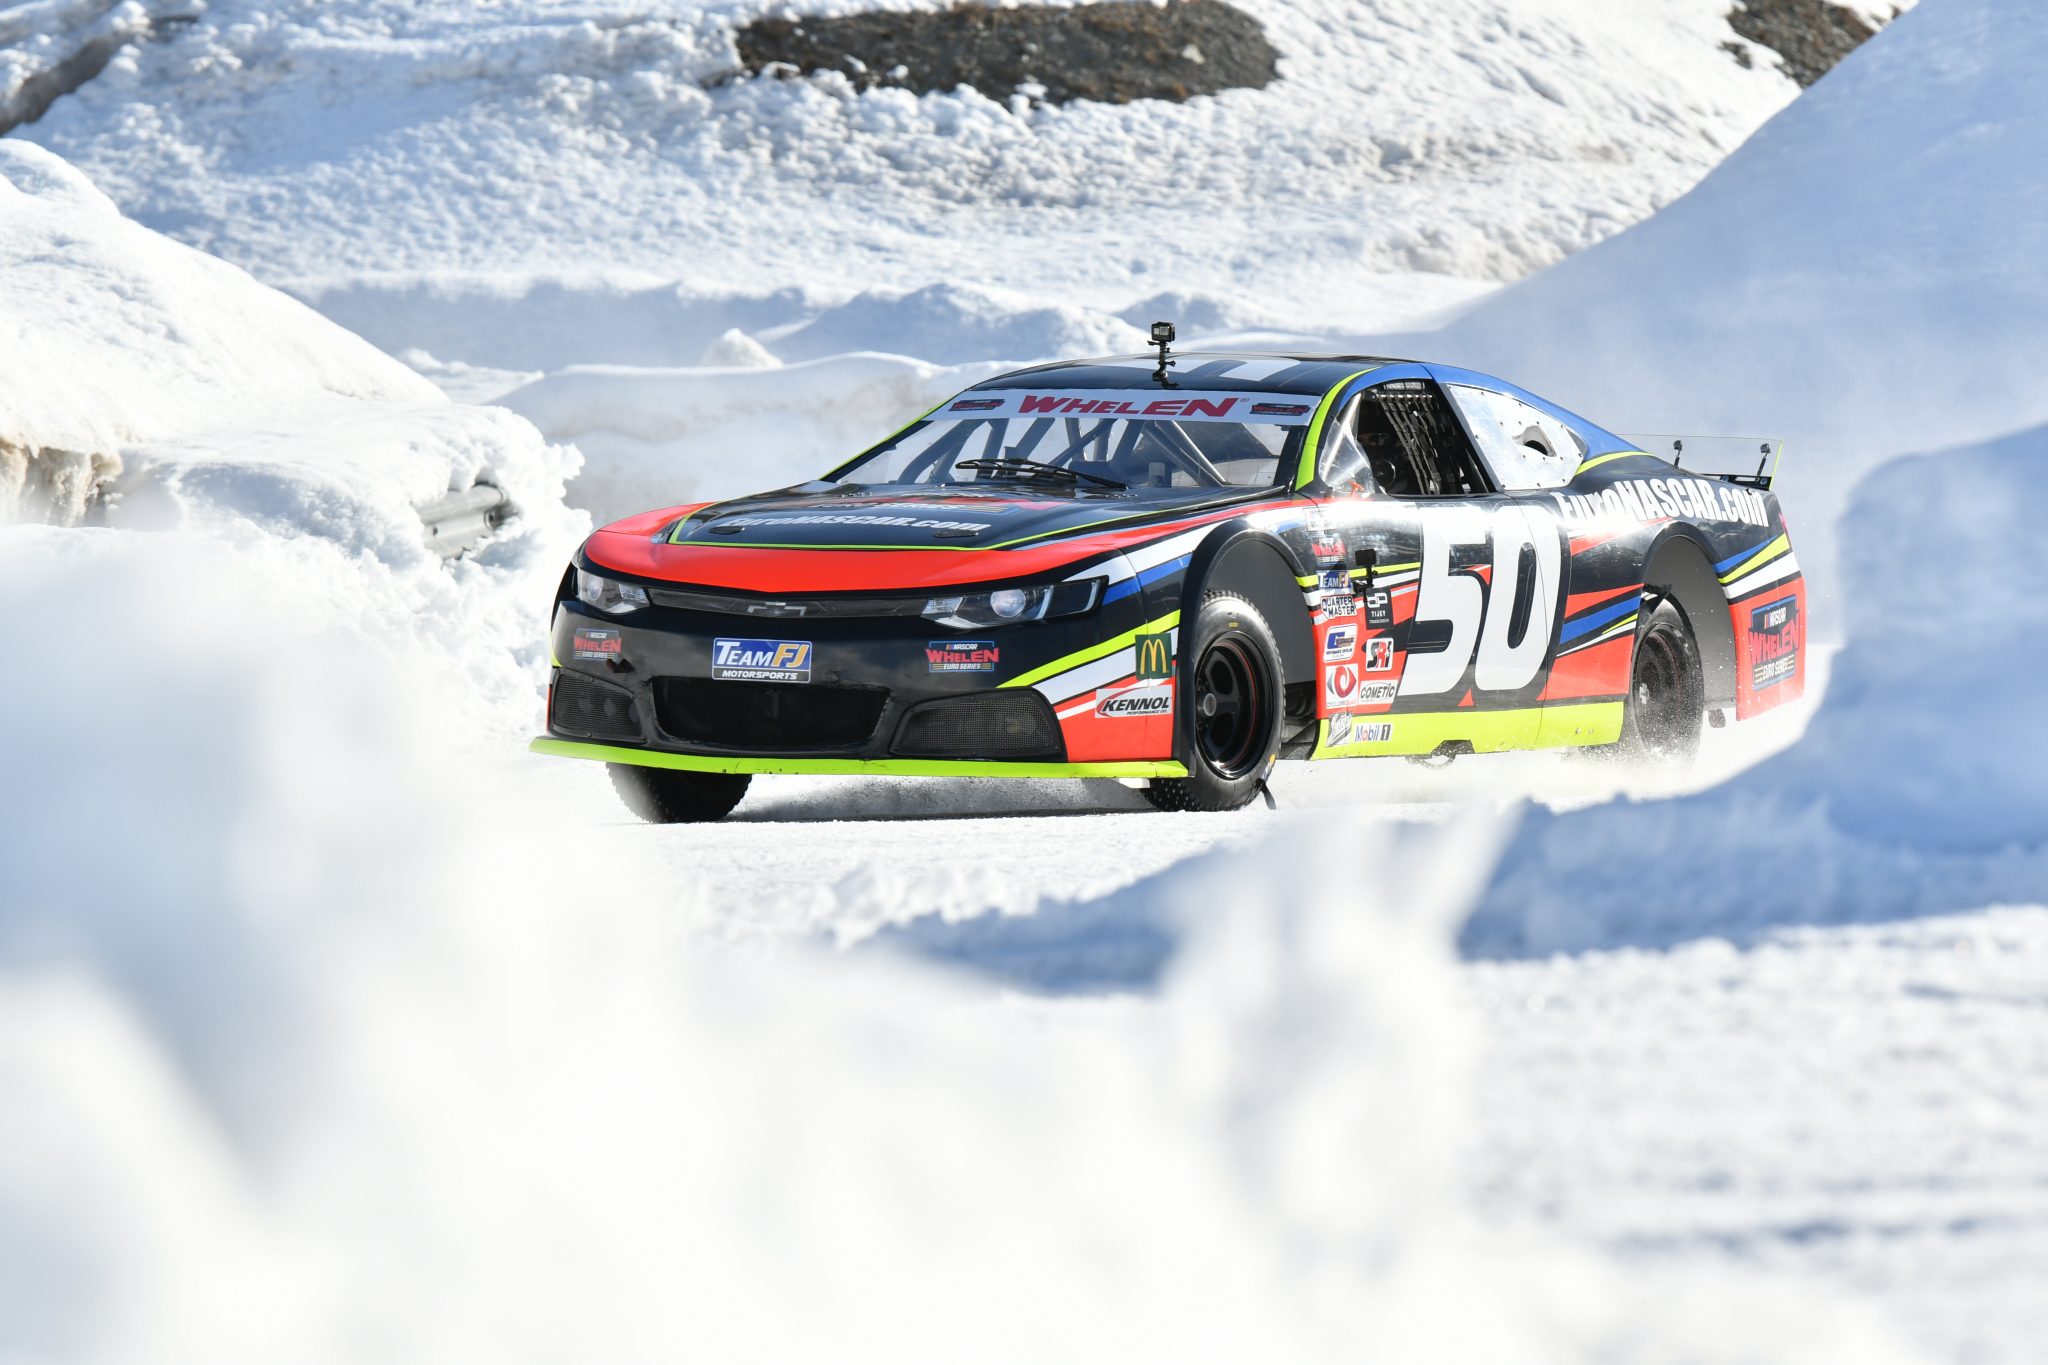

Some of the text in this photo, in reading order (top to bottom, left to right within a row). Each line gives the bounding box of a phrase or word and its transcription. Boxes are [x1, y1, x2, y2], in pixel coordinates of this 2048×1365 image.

[1018, 394, 1239, 417] WHELEN
[1397, 504, 1562, 697] 50
[1328, 605, 1356, 618] MASTER
[573, 635, 623, 653] WHELEN
[1749, 610, 1801, 665] WHELEN
[925, 647, 1000, 663] WHELEN
[721, 669, 799, 681] MOTORSPORTS
[1360, 683, 1396, 700] COMETIC
[1101, 696, 1170, 712] KENNOL
[1355, 724, 1380, 742] Mobil
